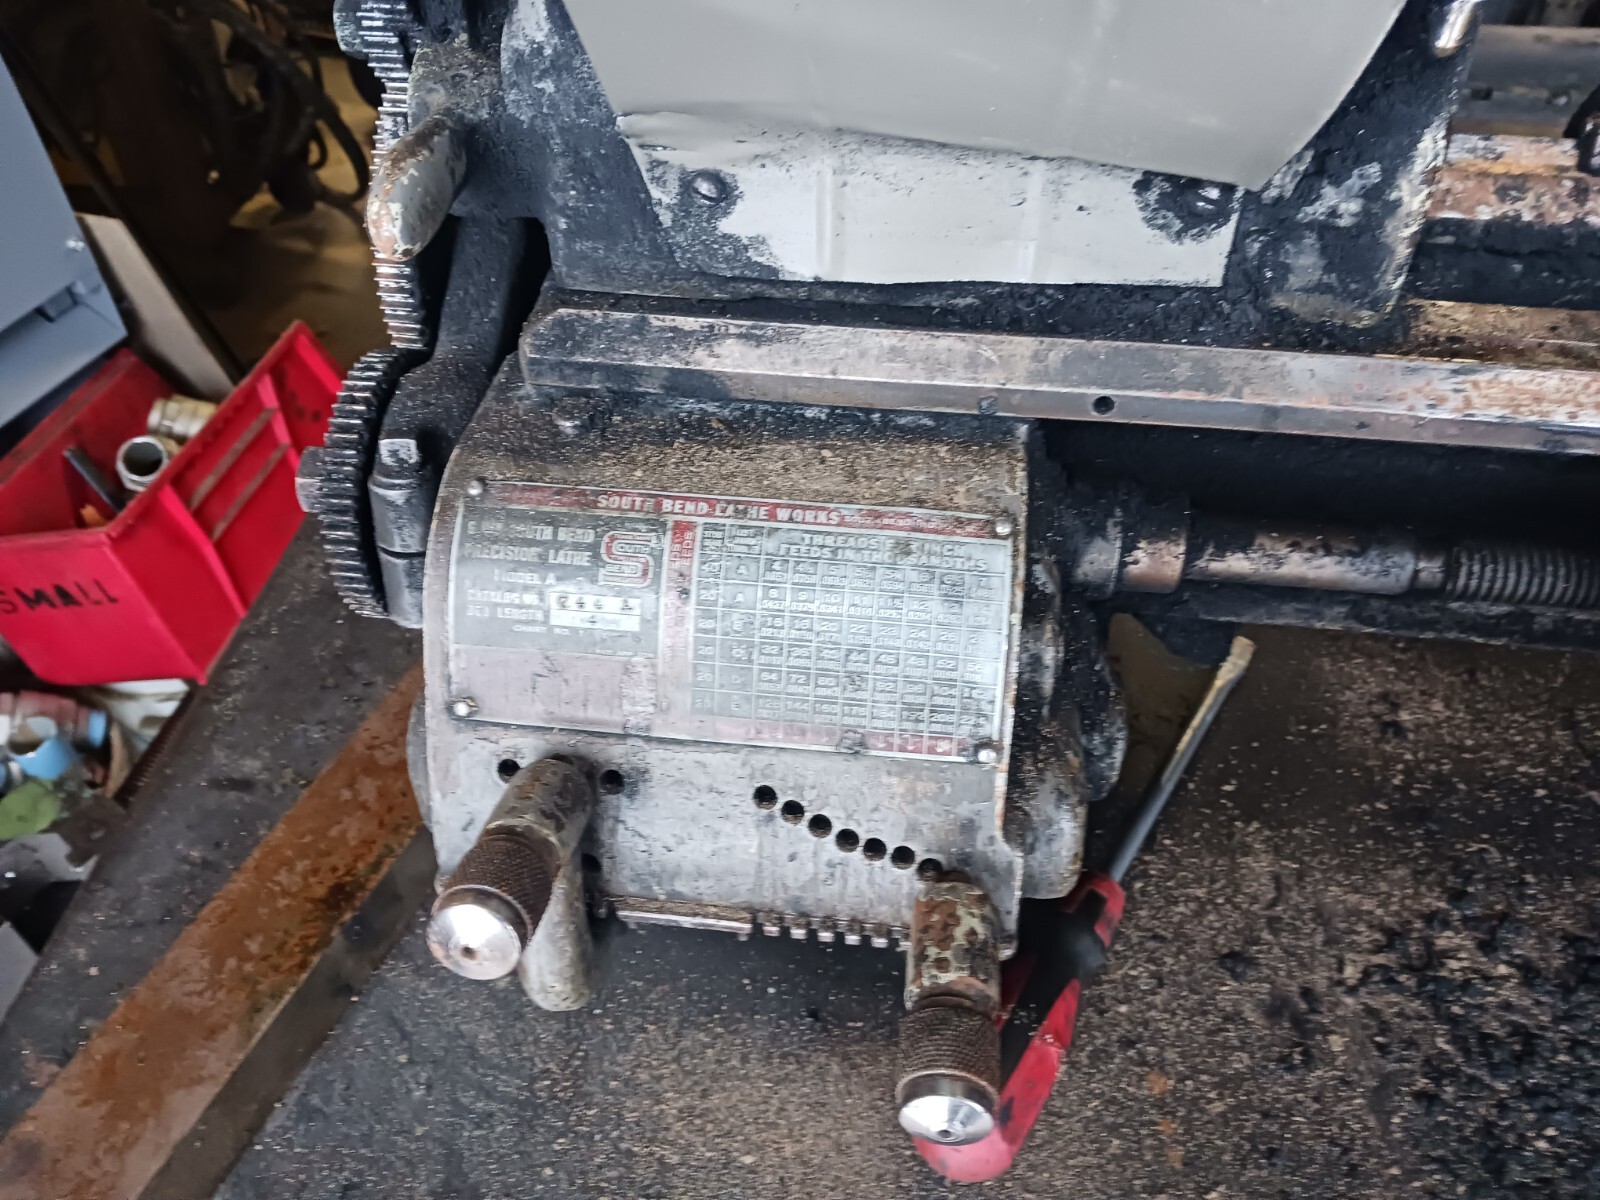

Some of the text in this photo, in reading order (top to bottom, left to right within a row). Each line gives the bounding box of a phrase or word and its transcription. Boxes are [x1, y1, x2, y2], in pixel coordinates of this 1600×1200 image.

[596, 495, 656, 512] SOUTH
[661, 500, 711, 516] BEND
[775, 507, 841, 524] WORKS
[777, 544, 833, 560] FEEDS
[736, 563, 749, 576] A
[733, 591, 746, 603] A
[767, 588, 780, 599] 8
[796, 590, 810, 602] 9
[823, 592, 842, 604] 10
[765, 616, 784, 628] 16
[849, 623, 868, 634] 22
[909, 628, 928, 639] 24
[696, 645, 715, 656] 20
[936, 658, 956, 670] 52
[760, 671, 780, 682] 64
[788, 672, 808, 685] 72
